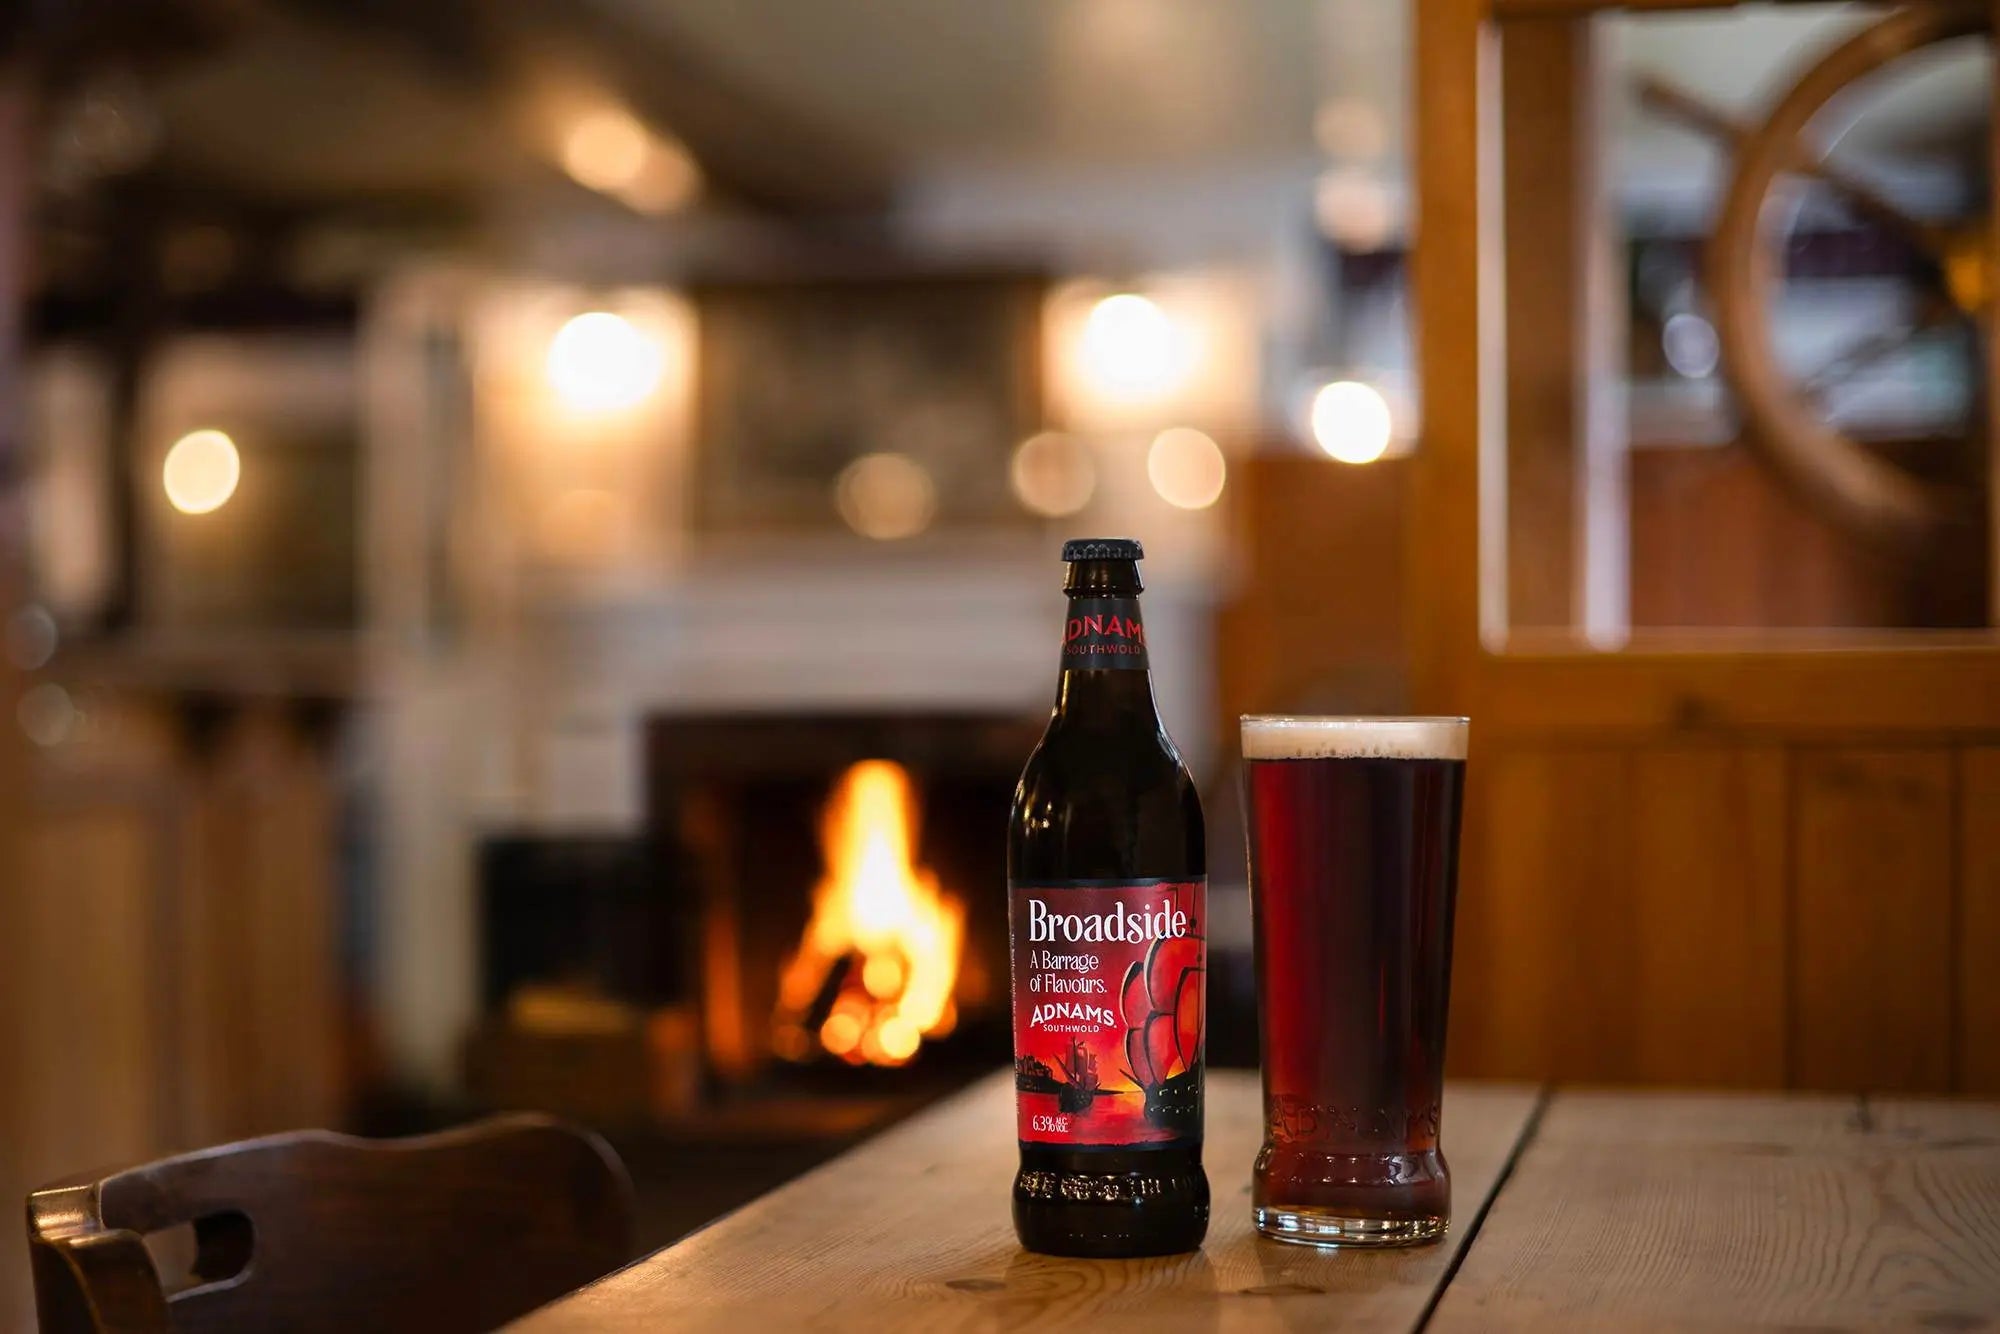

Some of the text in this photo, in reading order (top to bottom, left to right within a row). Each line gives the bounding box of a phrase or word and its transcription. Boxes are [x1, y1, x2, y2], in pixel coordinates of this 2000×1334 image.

[1061, 613, 1147, 648] DNAM
[1066, 644, 1141, 655] SOUTHWOLD
[1029, 899, 1187, 944] Broadside
[1030, 950, 1099, 974] A Barrage
[1030, 973, 1107, 993] of Flavours.
[1043, 1024, 1100, 1033] SOUTHWOLD
[1033, 1115, 1055, 1132] 6.3%
